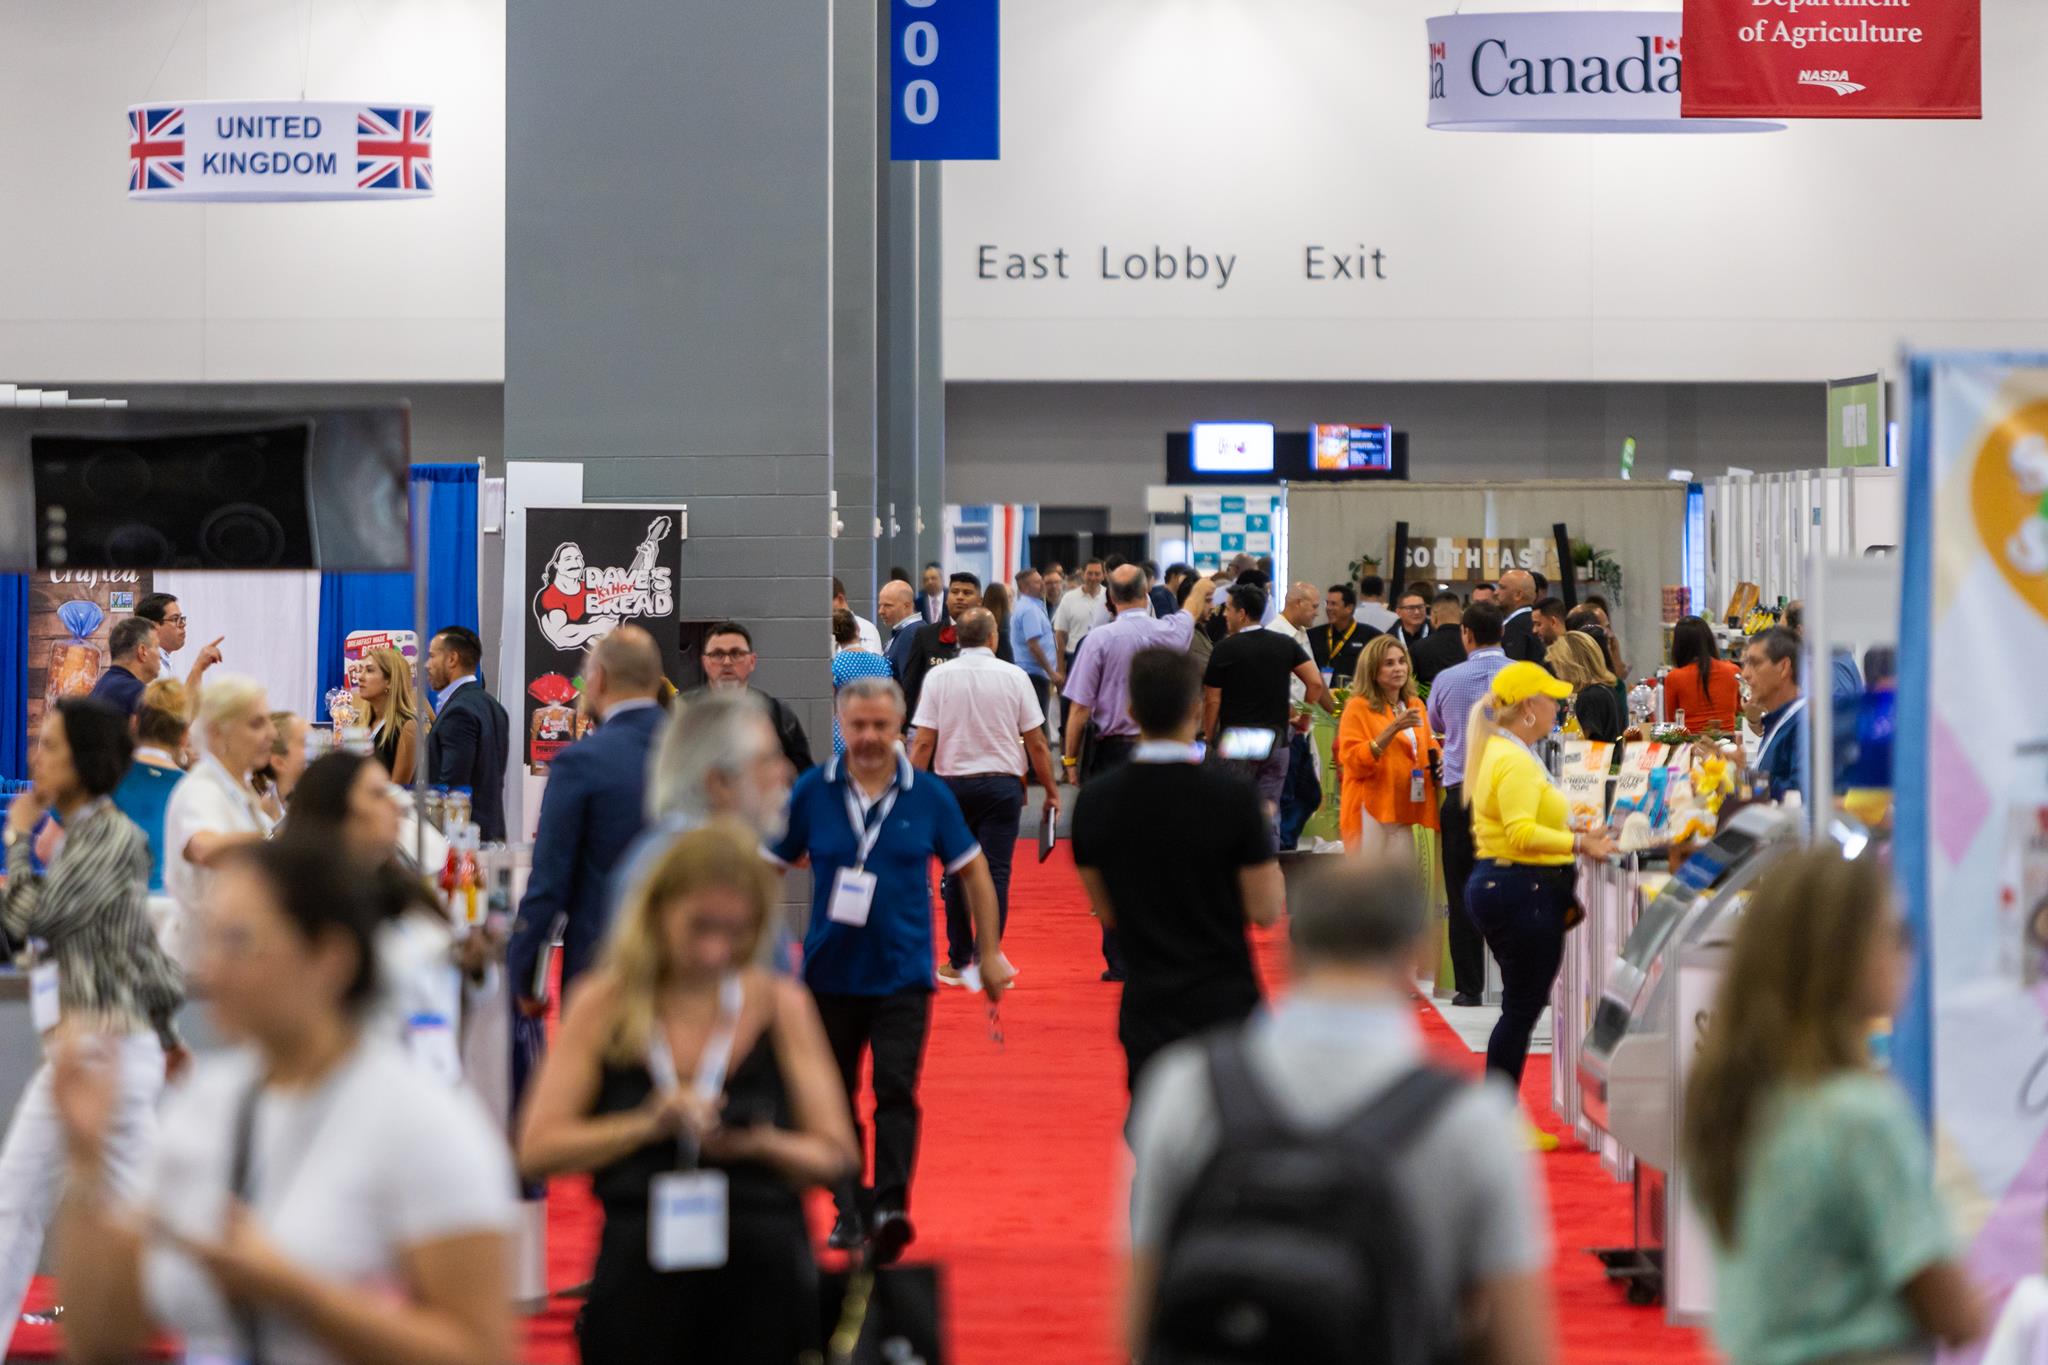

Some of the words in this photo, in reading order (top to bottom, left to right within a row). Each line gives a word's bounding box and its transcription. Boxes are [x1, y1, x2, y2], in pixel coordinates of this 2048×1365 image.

[1738, 19, 1768, 42] of
[1771, 19, 1923, 49] Agriculture
[1471, 36, 1681, 97] Canada
[1799, 70, 1849, 81] NASDA
[217, 116, 322, 139] UNITED
[203, 152, 337, 175] KINGDOM
[978, 245, 1070, 280] East
[1101, 245, 1236, 289] Lobby
[1306, 244, 1387, 280] Exit
[585, 566, 672, 591] DAVE'S
[585, 592, 673, 615] BREAD
